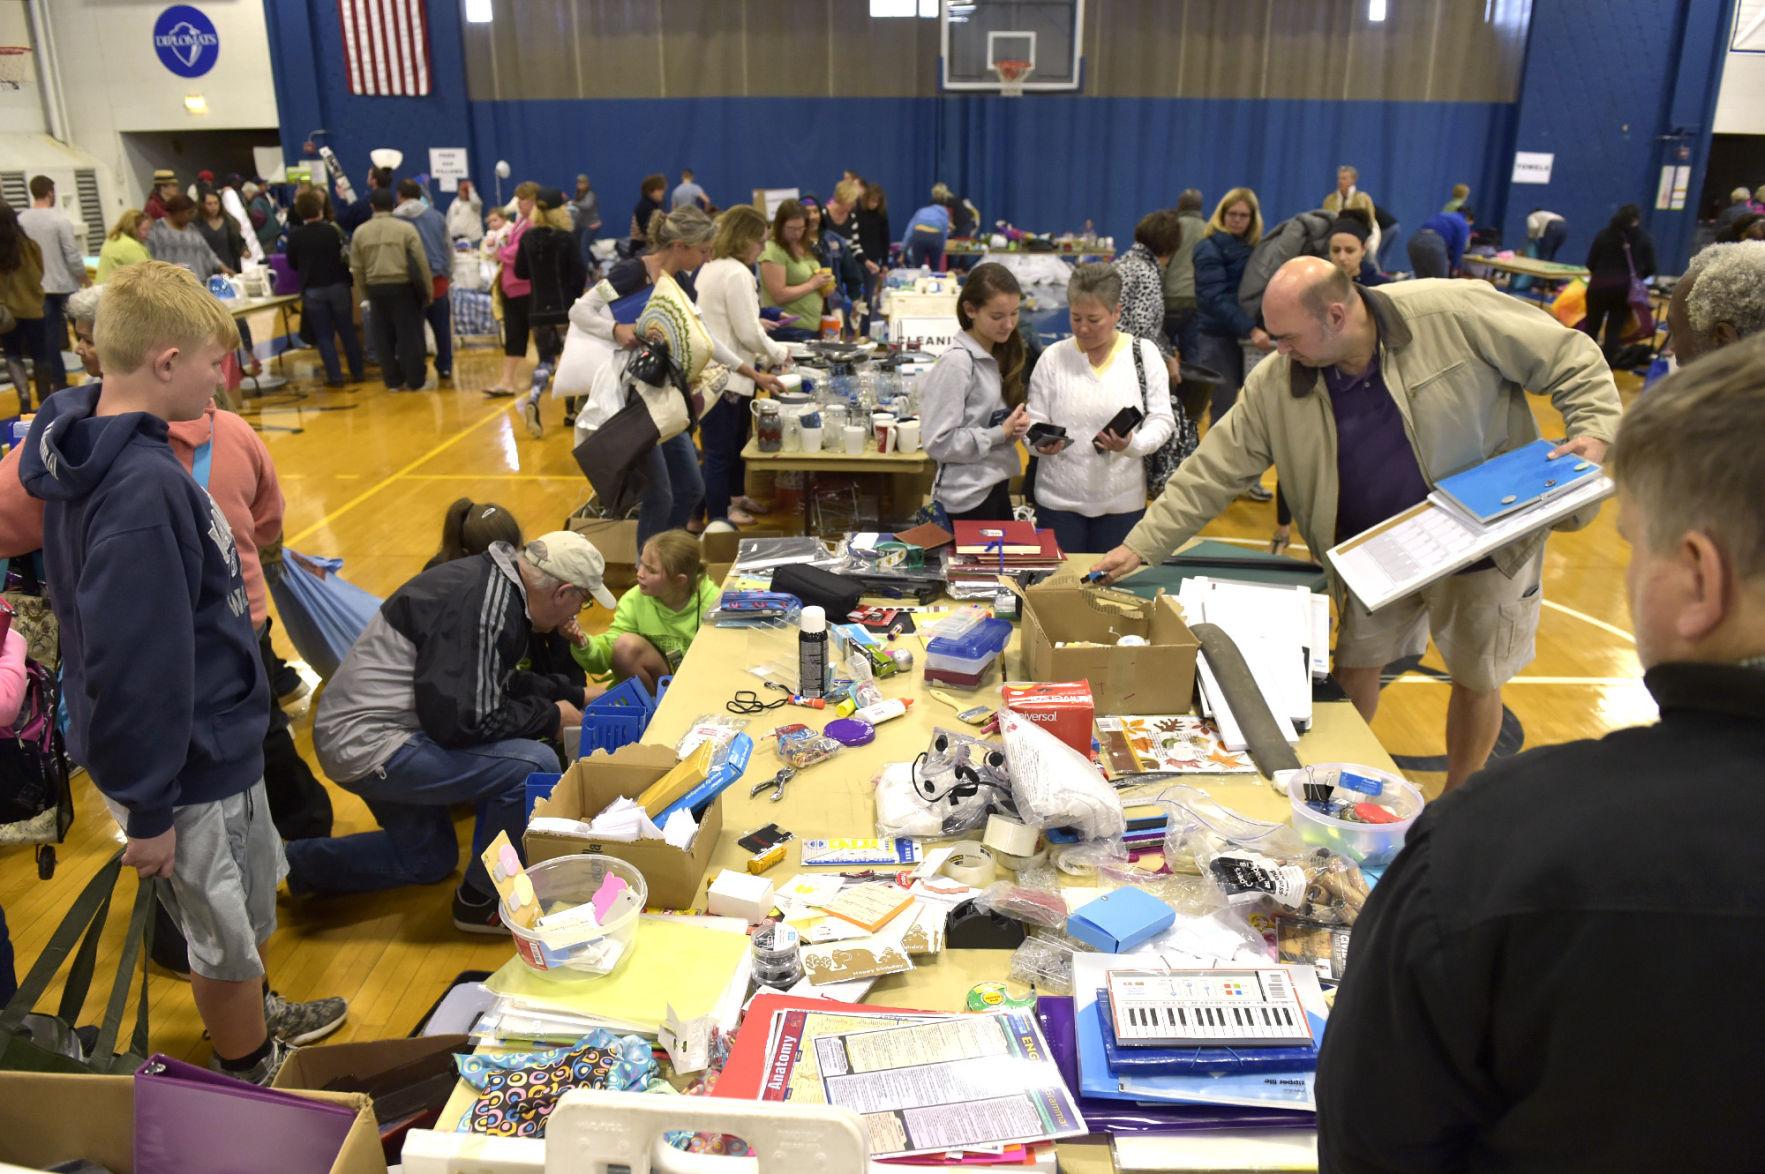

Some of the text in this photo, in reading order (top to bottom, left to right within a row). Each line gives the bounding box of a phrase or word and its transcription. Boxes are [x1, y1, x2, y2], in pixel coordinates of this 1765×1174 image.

[155, 33, 217, 47] DIPLOMATS
[897, 335, 952, 346] CLEANI
[1019, 710, 1058, 722] niversal
[1021, 1035, 1040, 1061] ENG
[767, 1035, 797, 1090] Anatomy
